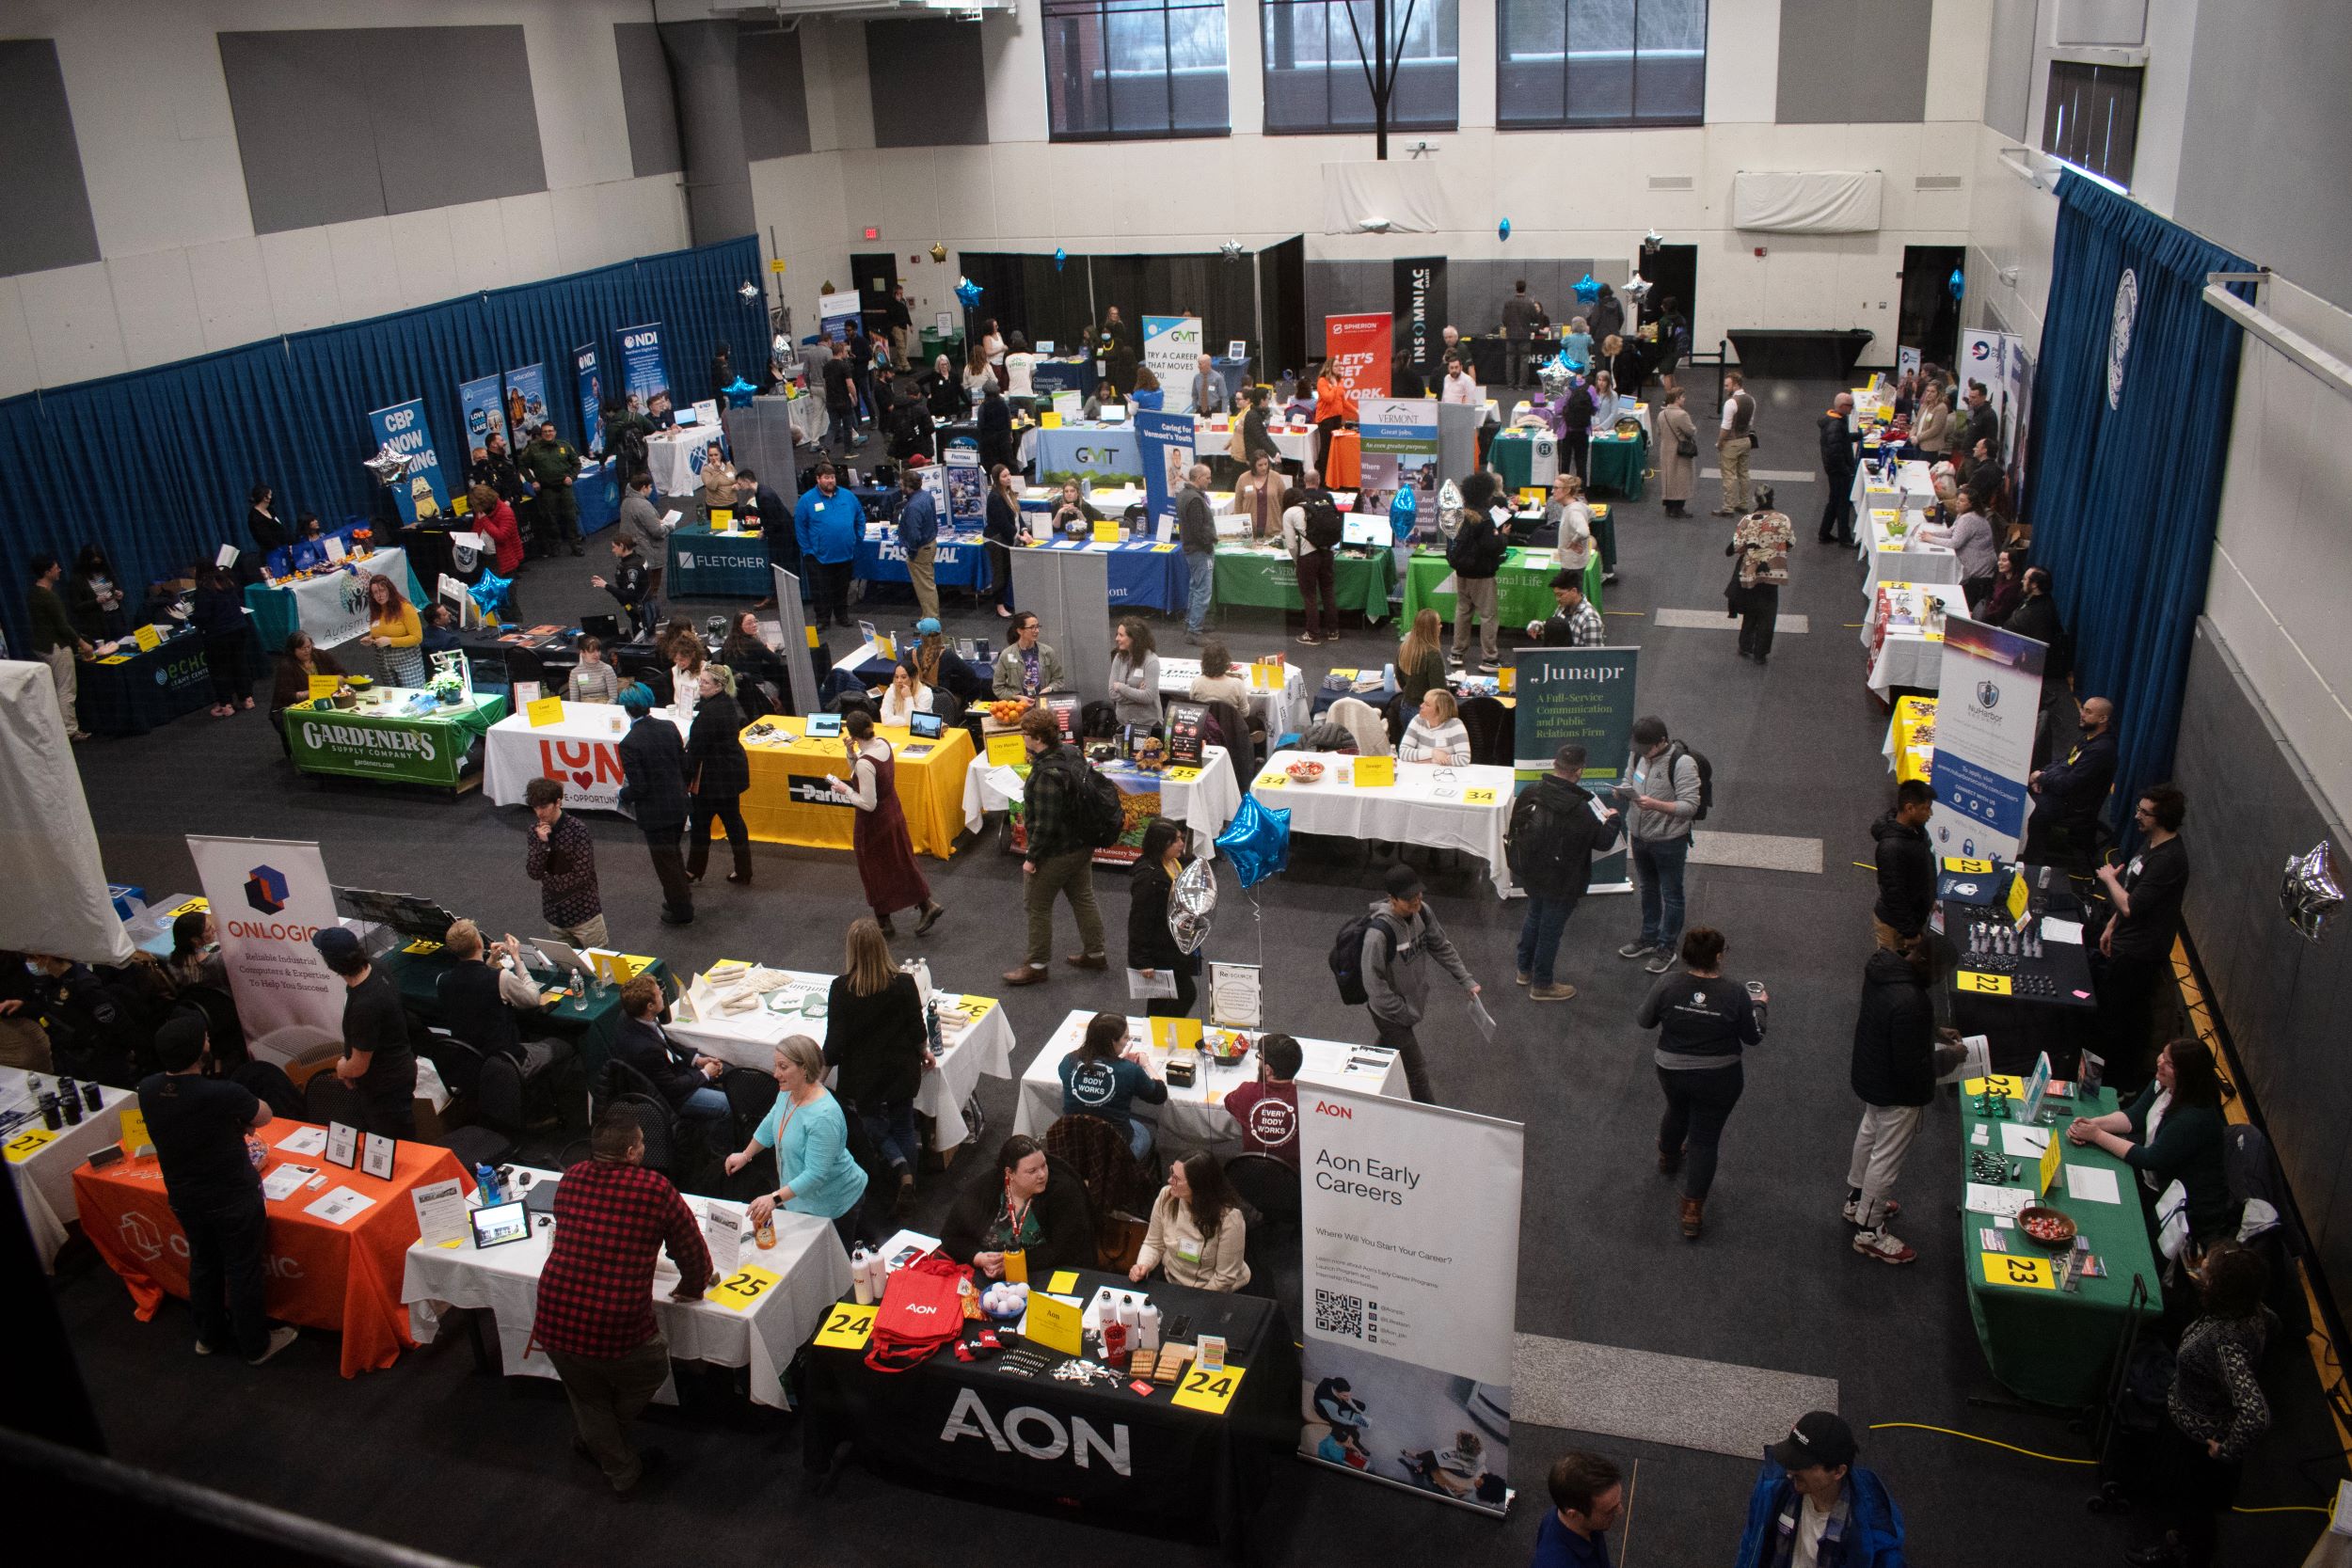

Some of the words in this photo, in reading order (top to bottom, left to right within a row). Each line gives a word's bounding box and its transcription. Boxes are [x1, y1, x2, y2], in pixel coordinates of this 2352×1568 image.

[866, 229, 877, 238] EXIT
[1412, 268, 1426, 363] INSOMNIAC
[635, 331, 659, 347] NDI
[1170, 330, 1200, 343] GMT
[583, 351, 596, 368] NDI
[1147, 351, 1161, 360] TRY
[1162, 352, 1168, 360] A
[1169, 352, 1199, 361] CAREER
[1148, 361, 1166, 370] THAT
[1168, 361, 1194, 371] MOVES
[385, 409, 415, 433] CBP
[470, 411, 485, 420] LOVE
[1378, 413, 1419, 424] VERMONT
[472, 423, 487, 433] LAKE
[1161, 423, 1180, 435] Caring
[1380, 427, 1397, 436] Great
[389, 429, 423, 453] NOW
[1143, 430, 1174, 441] Vermont's
[1174, 433, 1193, 443] Youth
[1075, 446, 1120, 465] GMT
[406, 450, 437, 475] RING
[1361, 462, 1380, 470] Where
[696, 555, 765, 568] FLETCHER
[1279, 566, 1297, 576] VERM
[1522, 576, 1543, 587] Life
[323, 618, 363, 641] Autism
[191, 668, 209, 679] CENTE
[1543, 663, 1625, 684] Junapr
[1537, 694, 1545, 703] A
[1546, 692, 1604, 703] Full-Service
[1536, 705, 1613, 715] Communication
[1968, 704, 2003, 722] NuHarbor
[1536, 718, 1553, 726] and
[1556, 717, 1586, 726] Public
[1536, 728, 1580, 738] Relations
[1581, 727, 1605, 736] Firm
[331, 745, 365, 755] SUPPLY
[369, 748, 413, 760] COMPANY
[354, 759, 395, 769] gardeners.com
[539, 739, 625, 785] LUN
[1171, 769, 1198, 779] 35
[1259, 776, 1287, 784] 34
[573, 795, 618, 805] OPPORTUN
[803, 784, 855, 805] Parke
[1467, 791, 1493, 800] 34
[1955, 784, 1976, 797] CONNECT
[1977, 792, 1988, 802] WITH
[1989, 798, 1996, 806] US
[1104, 847, 1127, 857] Grocery
[1961, 860, 1982, 872] 22
[245, 953, 278, 962] Reliable
[278, 955, 317, 966] Industrial
[239, 965, 283, 977] Computers
[284, 968, 292, 976] &
[292, 969, 330, 981] Expertise
[249, 979, 259, 988] To
[260, 979, 280, 990] Help
[281, 981, 296, 990] You
[296, 982, 329, 993] Succeed
[1976, 974, 1999, 992] 22
[952, 1001, 989, 1018] 37
[1083, 1077, 1104, 1086] BODY
[1984, 1076, 2011, 1097] 23
[1078, 1085, 1105, 1095] WORKS
[1261, 1109, 1286, 1117] EVERY
[1315, 1101, 1352, 1119] AON
[1262, 1117, 1283, 1126] BODY
[1257, 1125, 1286, 1134] WORKS
[8, 1135, 49, 1152] 27
[1316, 1148, 1359, 1174] Aon
[1367, 1158, 1421, 1190] Early
[1316, 1171, 1403, 1206] Careers
[1315, 1227, 1343, 1239] Where
[1344, 1231, 1359, 1242] Will
[1360, 1236, 1375, 1247] You
[1376, 1241, 1396, 1252] Start
[1399, 1245, 1417, 1257] Your
[1418, 1250, 1453, 1265] Career?
[1315, 1263, 1336, 1273] Launch
[1336, 1267, 1359, 1278] Program
[1346, 1261, 1362, 1270] about
[1377, 1269, 1391, 1278] Early
[1392, 1272, 1410, 1282] Career
[2007, 1258, 2039, 1285] 23
[723, 1273, 769, 1299] 25
[1315, 1271, 1343, 1282] Internship
[1343, 1277, 1379, 1291] Opportunities
[906, 1302, 937, 1315] AON
[1047, 1309, 1060, 1321] Aon
[826, 1314, 872, 1336] 24
[1184, 1371, 1232, 1398] 24
[940, 1387, 1131, 1476] AON
